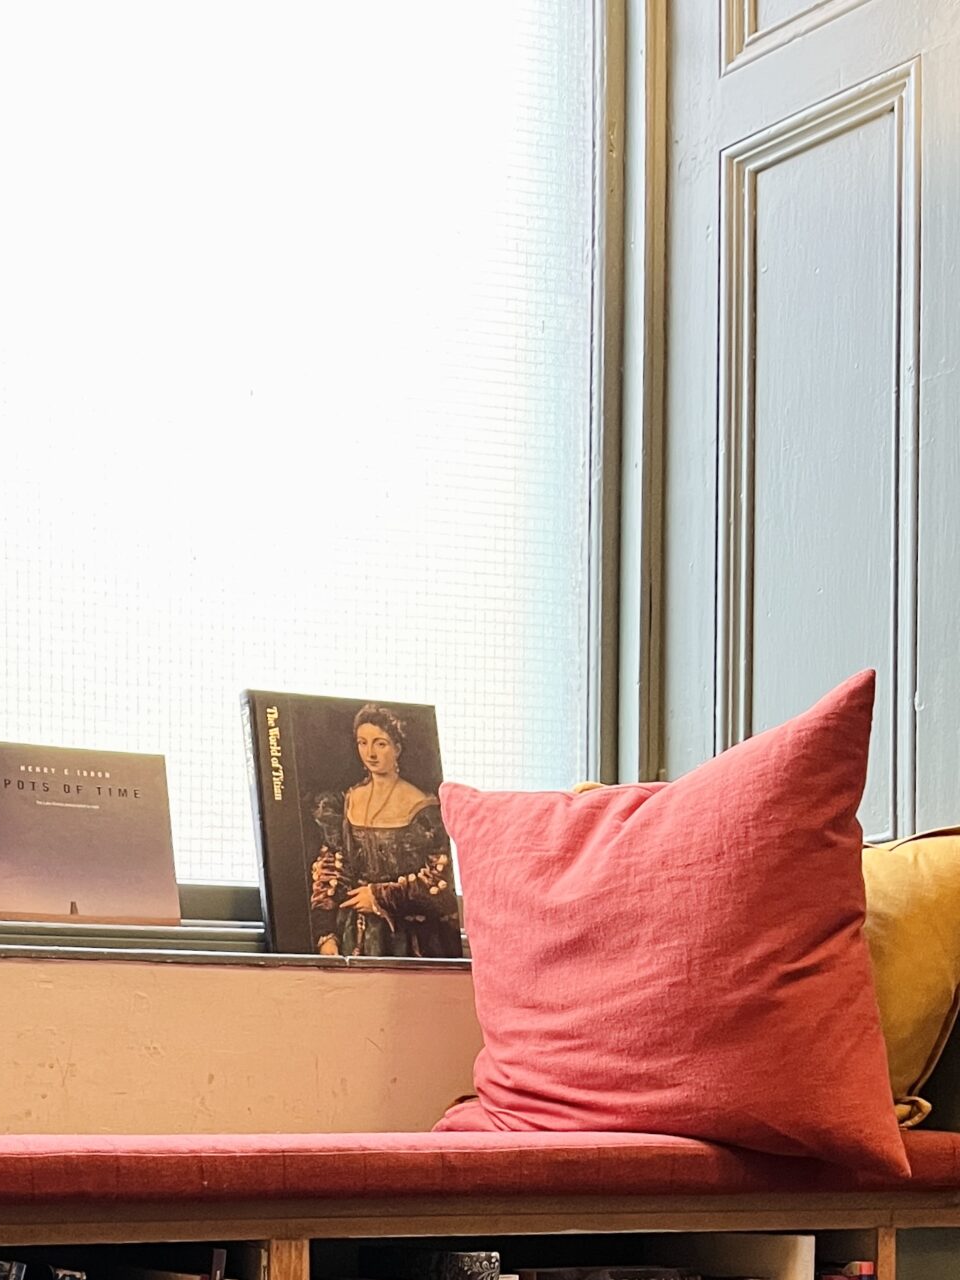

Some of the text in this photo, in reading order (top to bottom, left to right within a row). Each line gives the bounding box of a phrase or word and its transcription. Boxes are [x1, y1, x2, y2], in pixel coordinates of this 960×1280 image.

[266, 706, 285, 800] The World of Titian
[63, 783, 83, 794] OF
[97, 786, 141, 799] TIME
